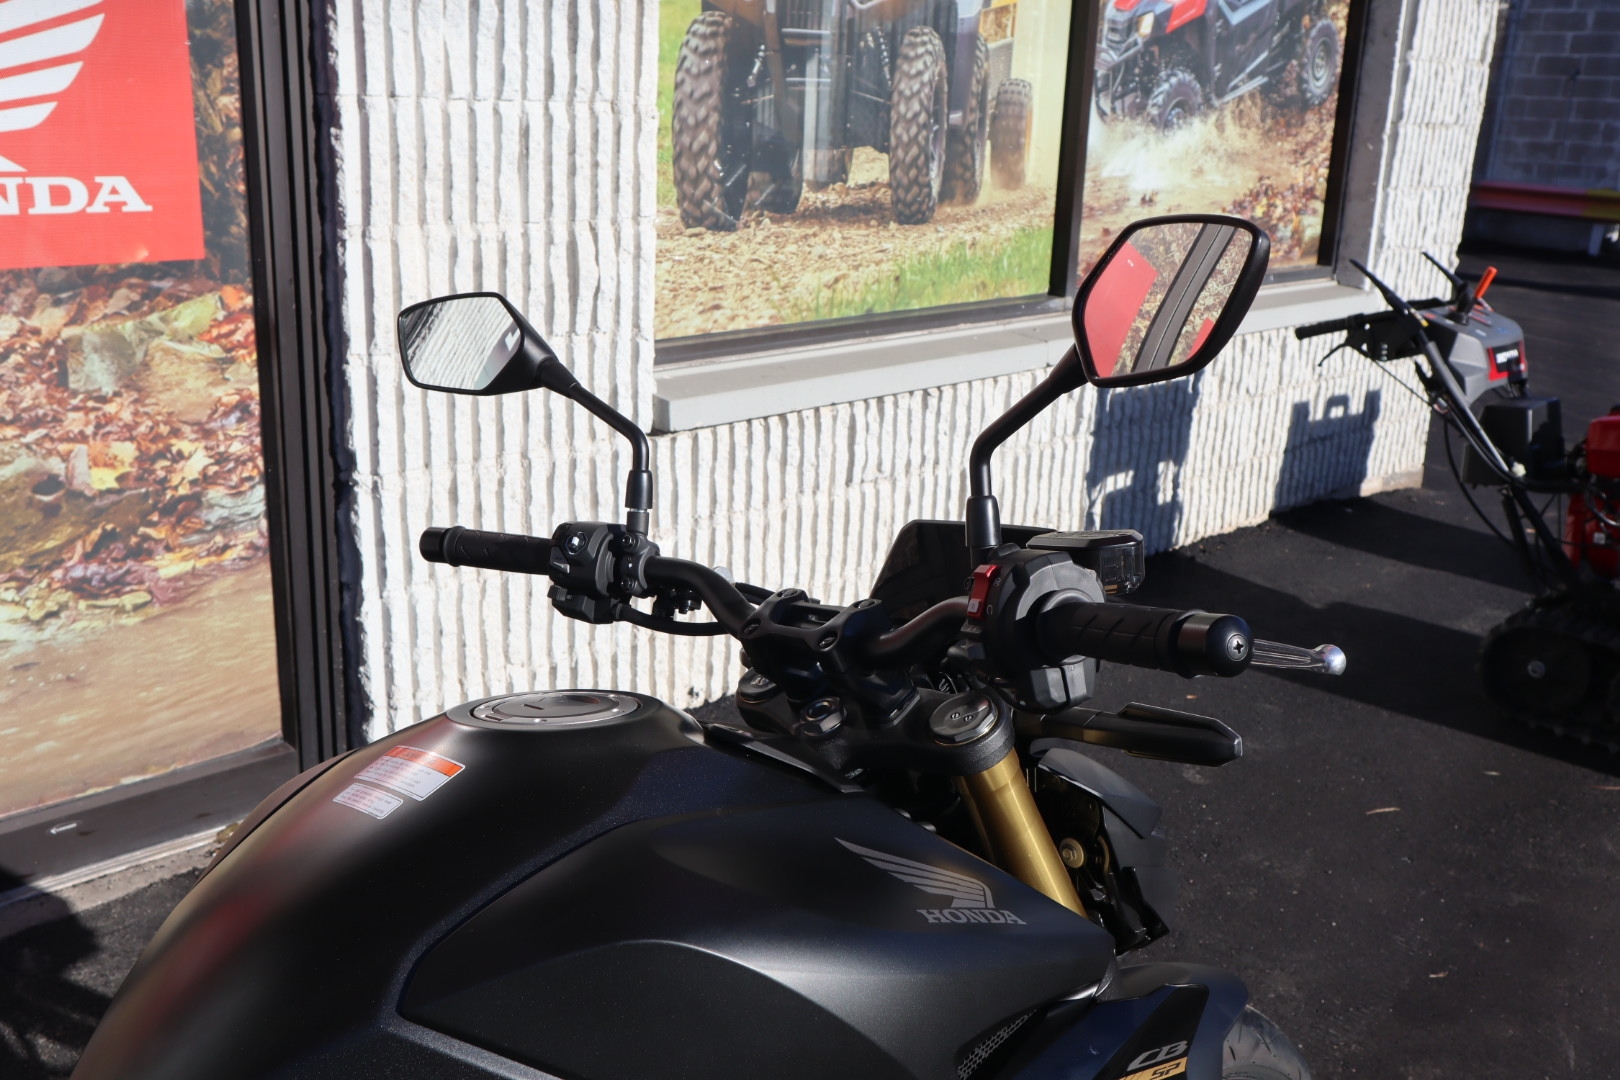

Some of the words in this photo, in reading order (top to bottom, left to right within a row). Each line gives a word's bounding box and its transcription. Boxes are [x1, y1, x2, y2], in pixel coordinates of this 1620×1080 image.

[916, 909, 1027, 925] HONDA
[1126, 1040, 1188, 1072] CB
[1150, 1061, 1182, 1080] SP
